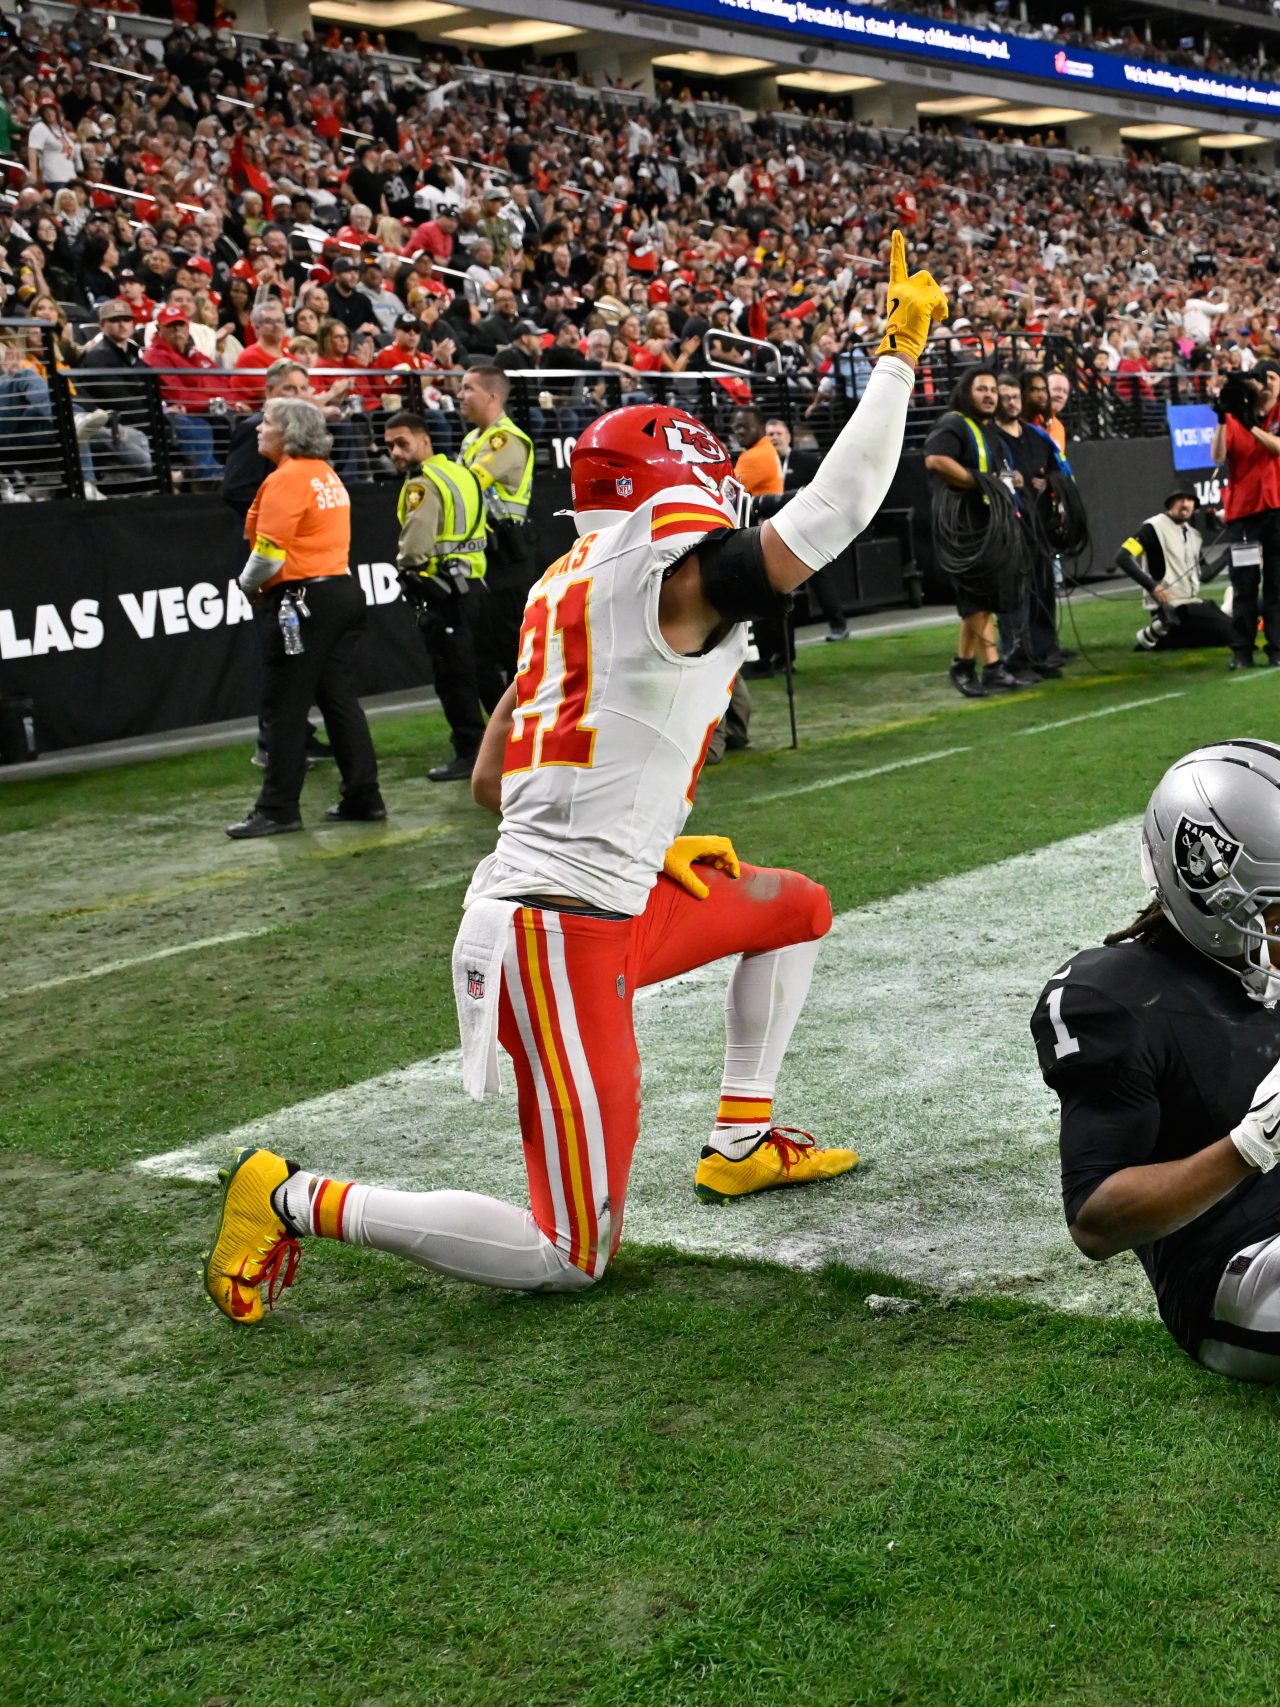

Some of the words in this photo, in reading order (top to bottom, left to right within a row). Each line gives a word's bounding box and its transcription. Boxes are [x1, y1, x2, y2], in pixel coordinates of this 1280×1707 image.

[0, 598, 105, 660] LAS
[118, 578, 254, 640] VEGA
[502, 577, 598, 778] 21
[1184, 821, 1233, 852] RAIERS
[469, 980, 485, 996] NFL
[1046, 985, 1080, 1060] 1
